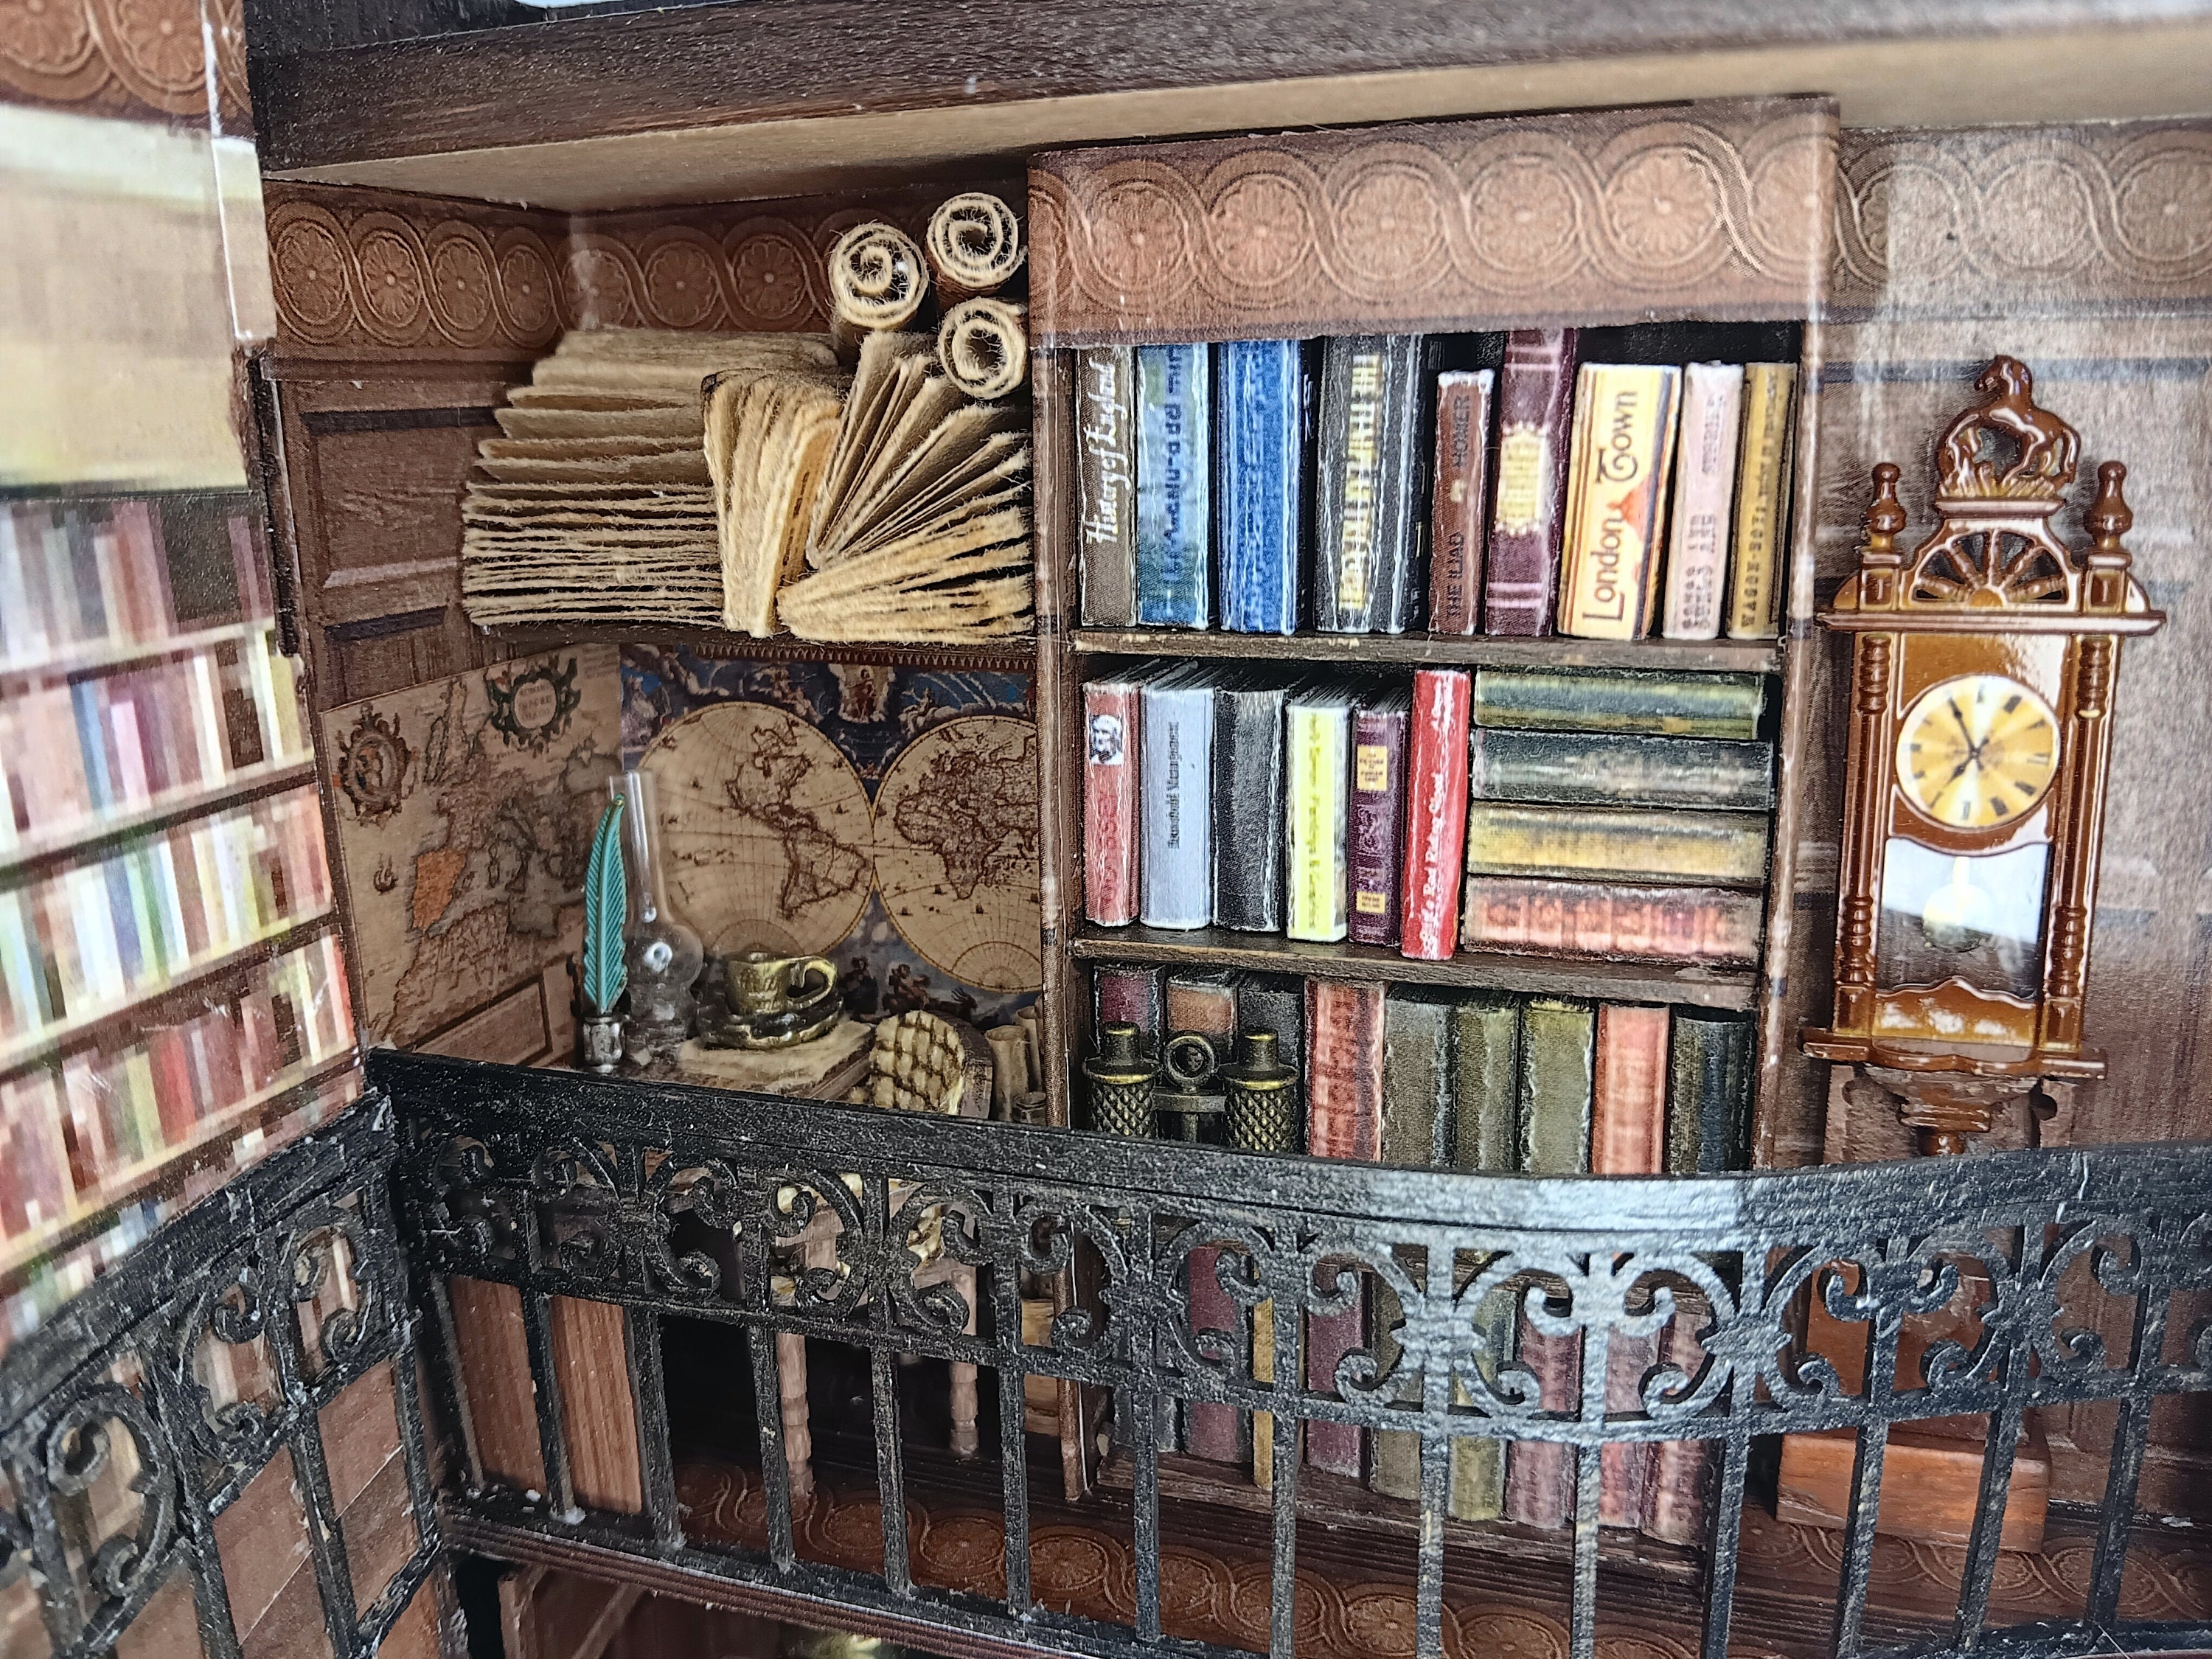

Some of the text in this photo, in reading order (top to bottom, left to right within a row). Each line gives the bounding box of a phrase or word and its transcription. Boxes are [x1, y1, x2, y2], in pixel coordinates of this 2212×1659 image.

[1083, 357, 1127, 447] England
[1453, 395, 1470, 468] HOMER
[1582, 389, 1639, 623] London Town
[1445, 532, 1464, 622] THE ILIAD
